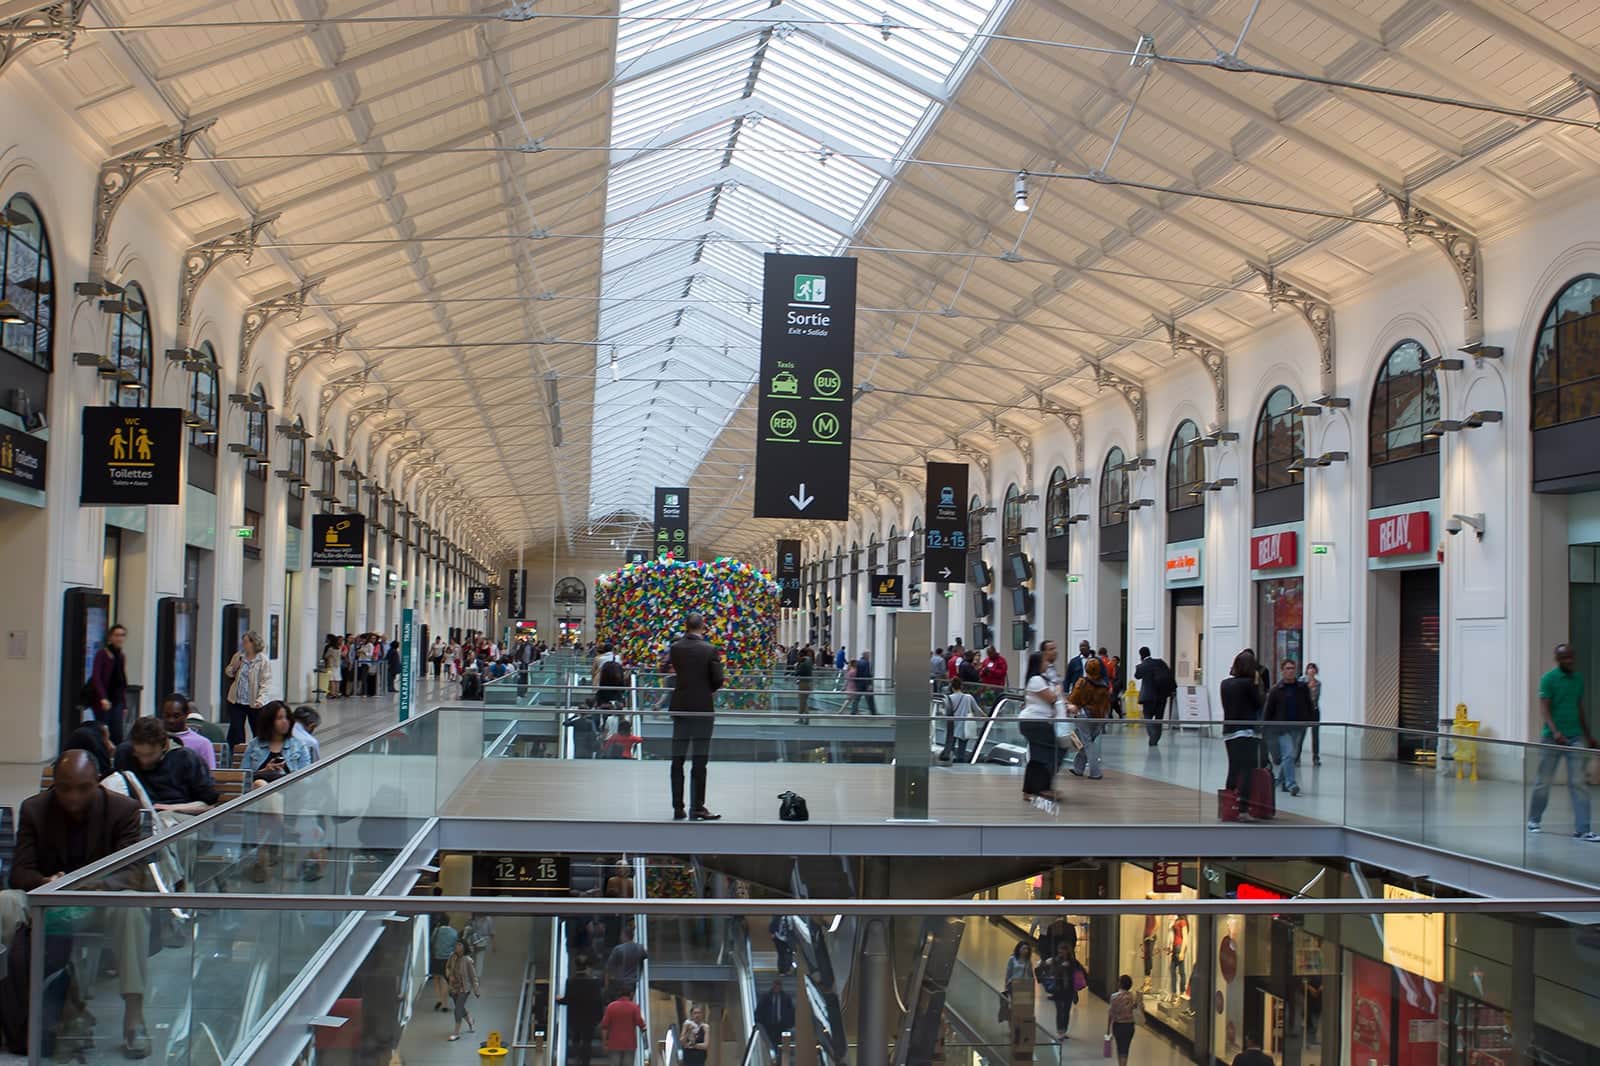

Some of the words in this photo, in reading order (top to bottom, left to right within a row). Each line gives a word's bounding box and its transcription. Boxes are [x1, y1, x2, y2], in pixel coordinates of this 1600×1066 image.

[787, 311, 830, 326] Sortie
[777, 361, 794, 369] Taxis
[818, 377, 838, 388] BUS
[124, 417, 141, 425] WC
[774, 418, 793, 429] RER
[818, 418, 833, 433] M
[109, 468, 153, 479] Toilettes
[1379, 513, 1410, 553] RELAY
[928, 535, 942, 546] 12
[951, 536, 965, 547] 15
[1258, 533, 1280, 567] RELAY
[495, 864, 515, 877] 12
[537, 864, 557, 878] 15
